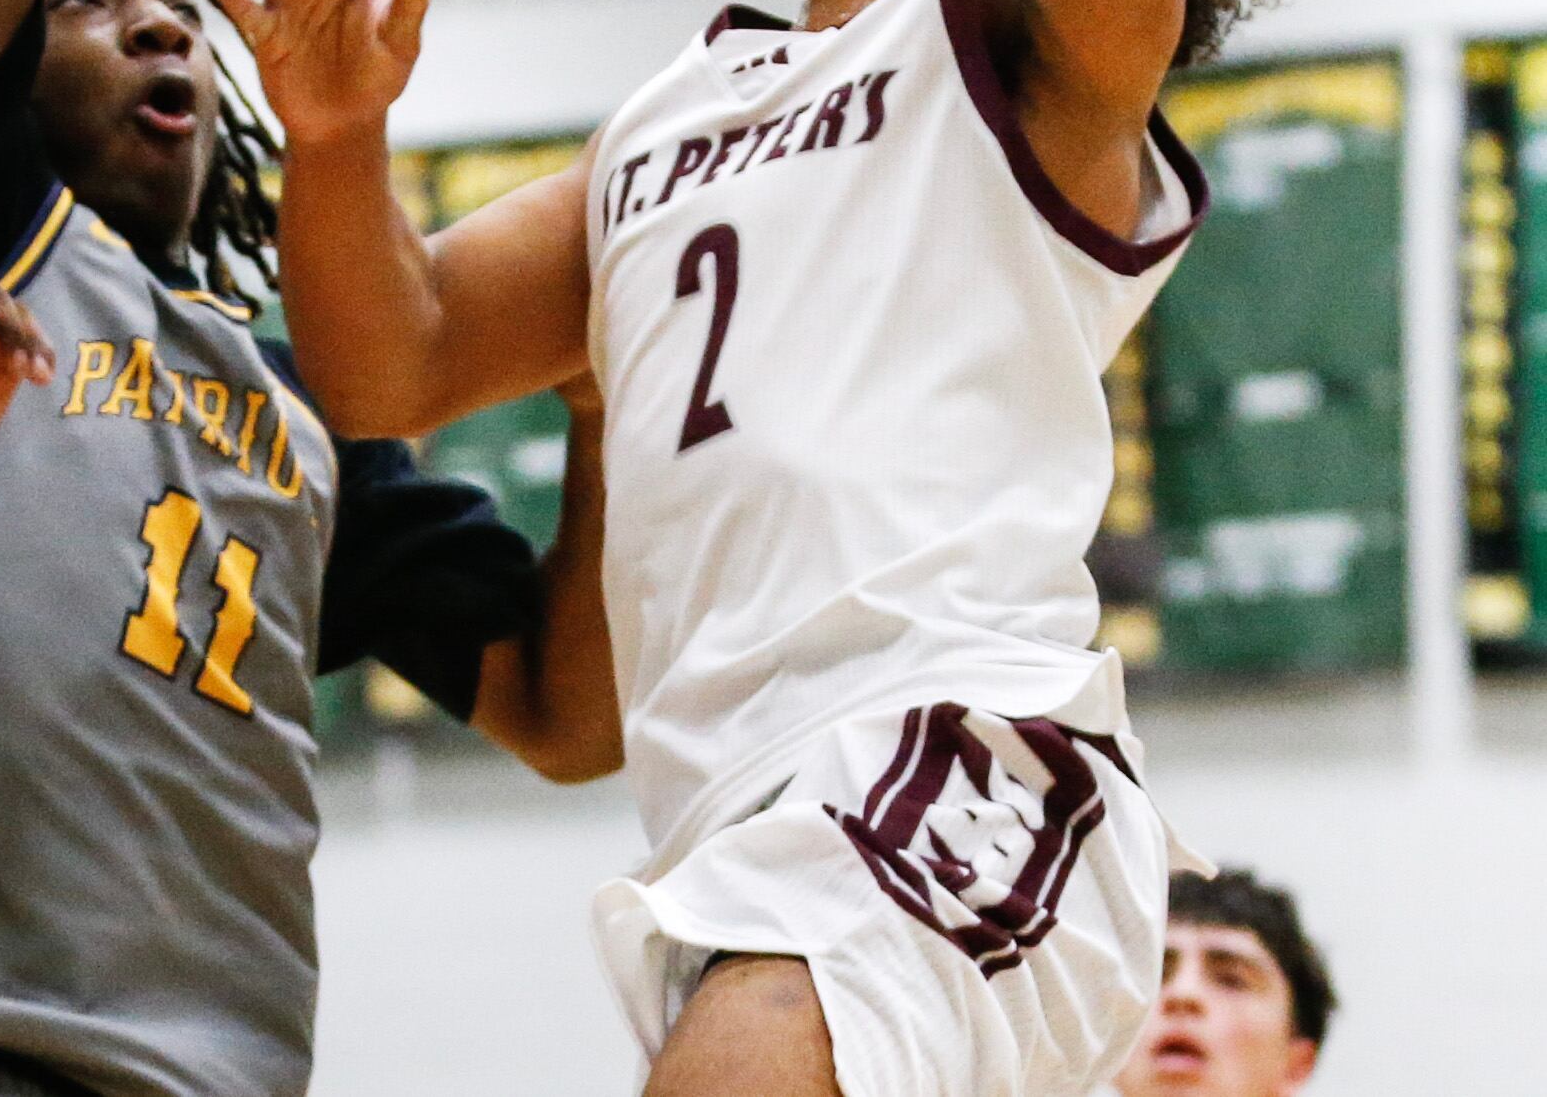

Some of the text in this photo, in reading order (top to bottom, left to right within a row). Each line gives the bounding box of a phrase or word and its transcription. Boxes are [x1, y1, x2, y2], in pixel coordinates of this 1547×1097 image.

[654, 70, 899, 206] PETER'S
[61, 337, 306, 500] PATRIO
[675, 223, 739, 453] 2
[120, 485, 261, 717] 11
